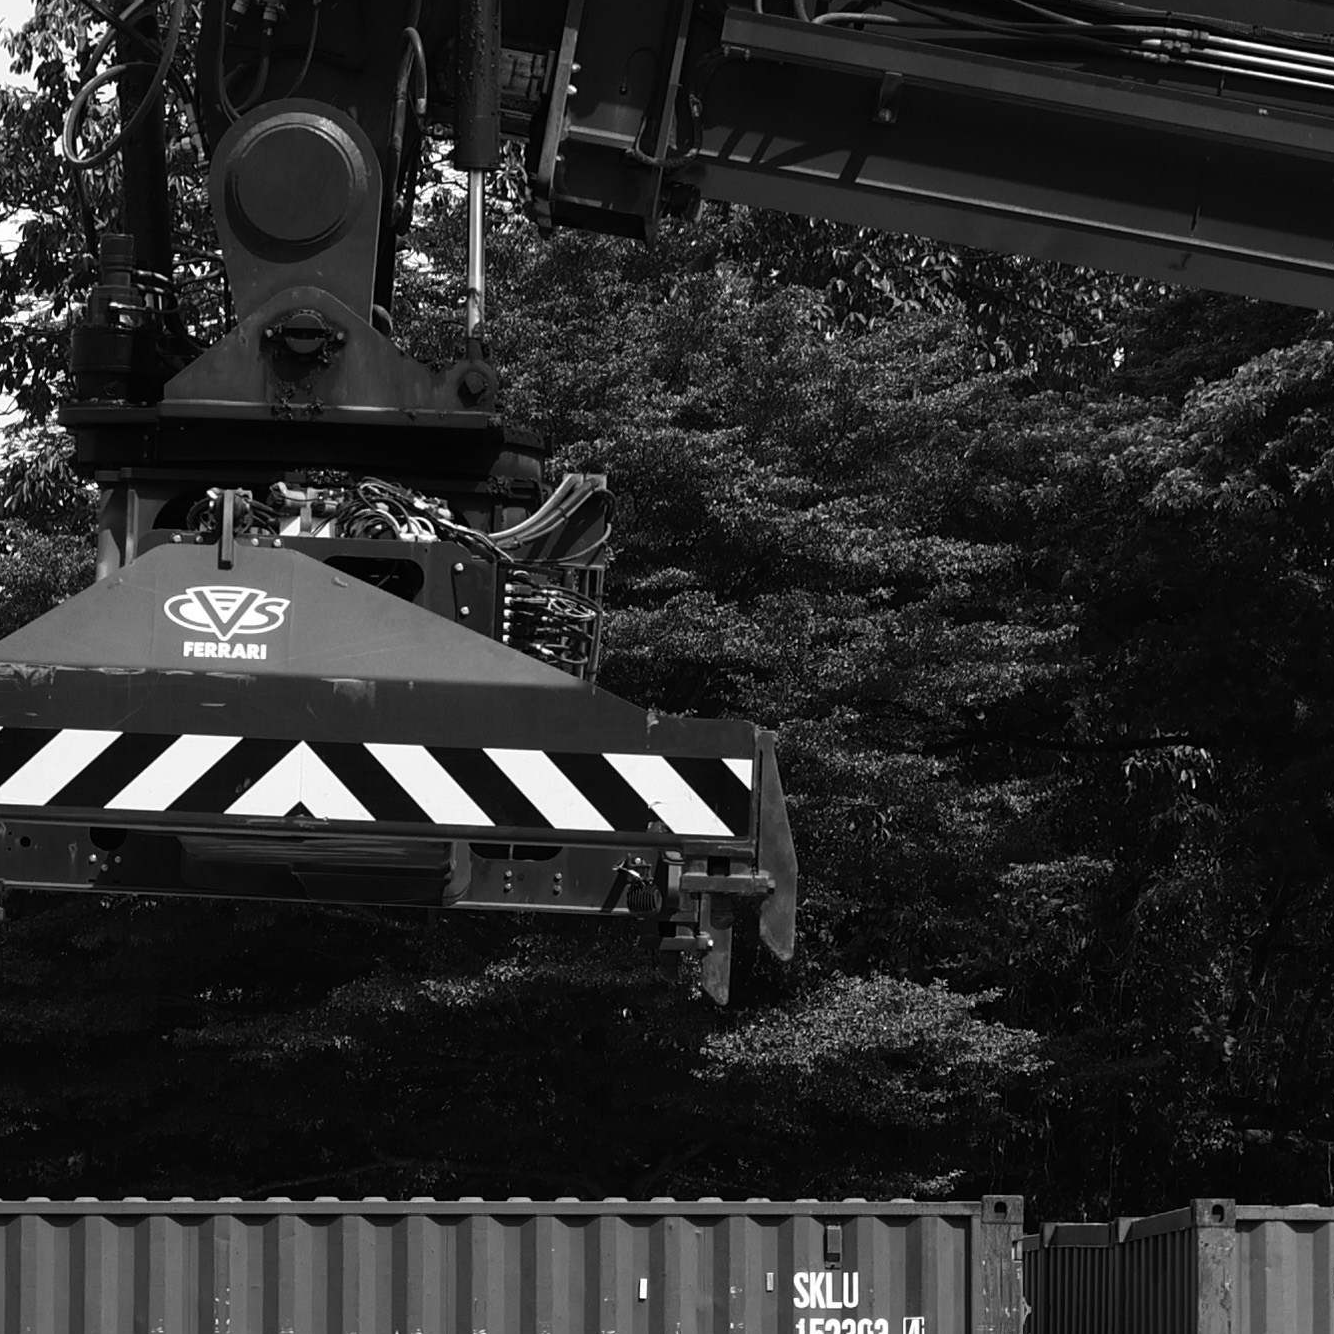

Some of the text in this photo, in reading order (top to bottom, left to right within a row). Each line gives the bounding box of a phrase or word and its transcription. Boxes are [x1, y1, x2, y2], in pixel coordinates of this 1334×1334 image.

[164, 586, 290, 641] CVS
[183, 641, 267, 660] FERRARI
[793, 1271, 859, 1309] SKLU
